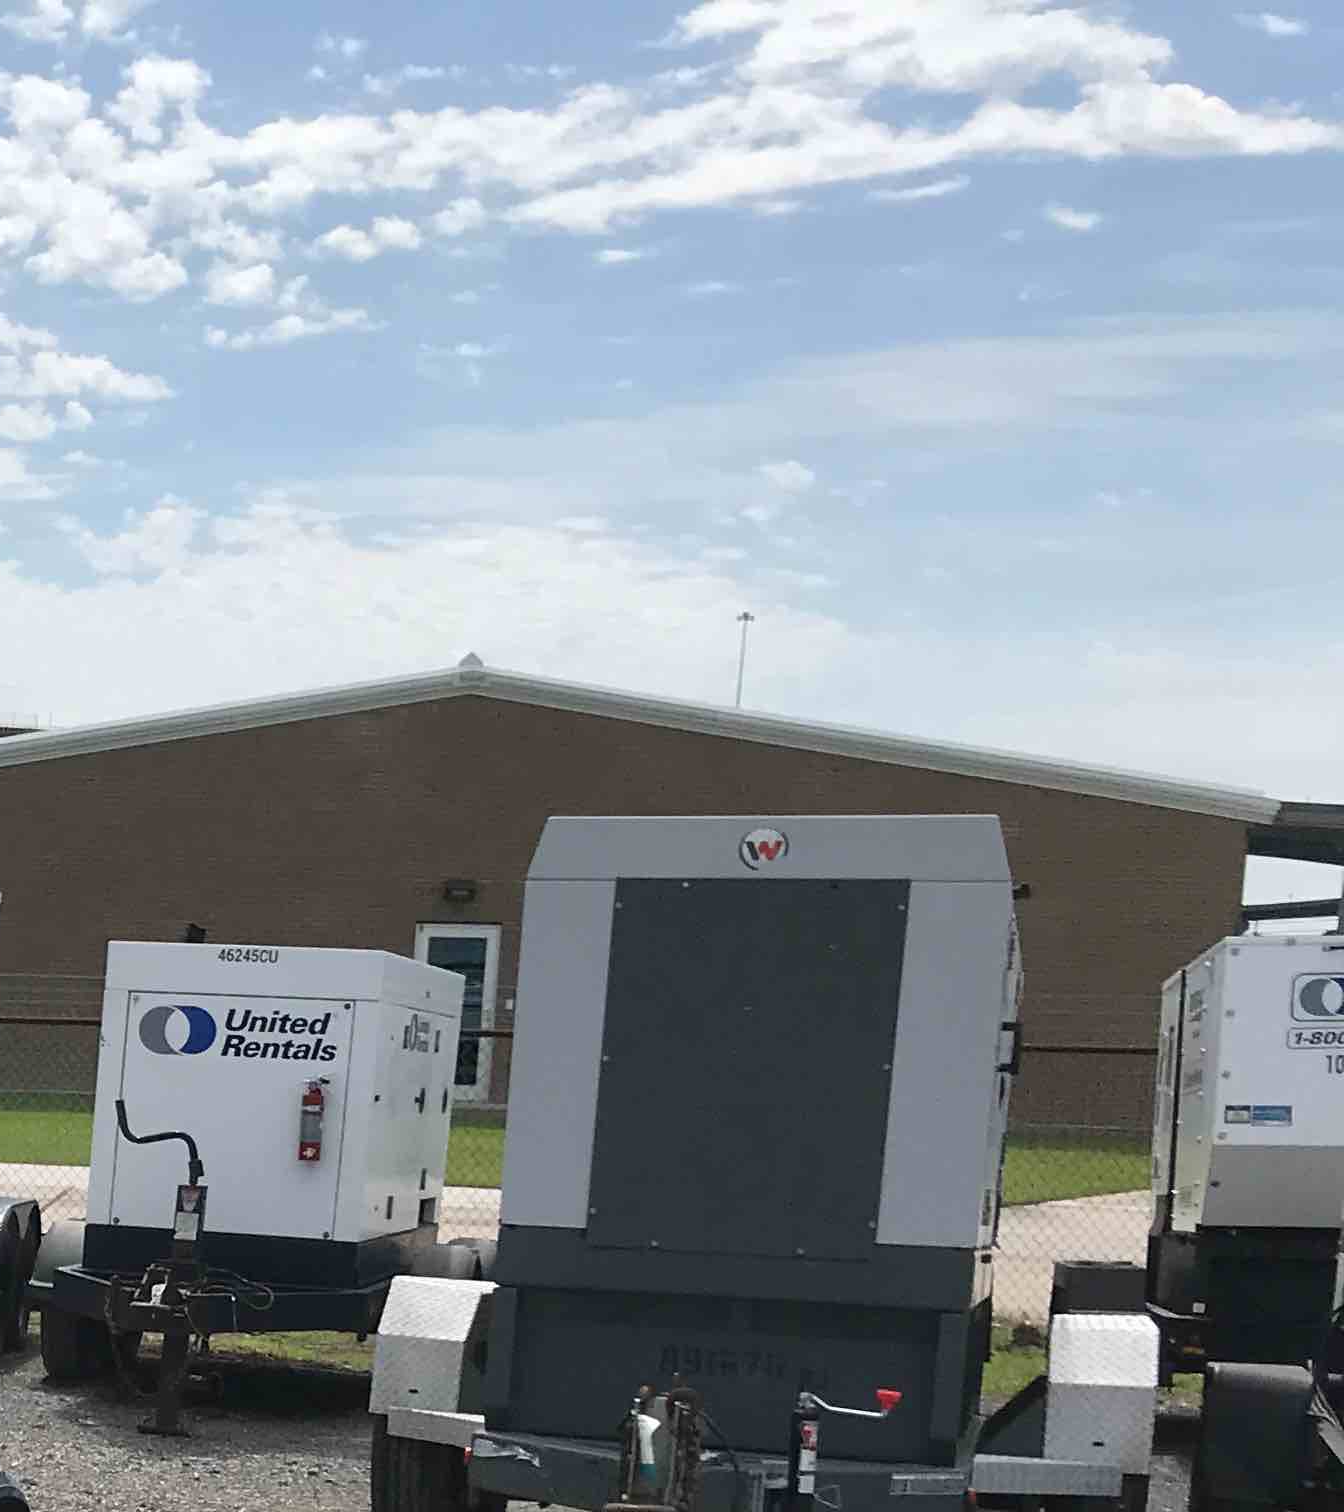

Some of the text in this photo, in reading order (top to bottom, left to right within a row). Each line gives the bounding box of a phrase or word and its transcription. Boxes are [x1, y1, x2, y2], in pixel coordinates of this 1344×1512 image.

[218, 949, 279, 964] 46245CU
[225, 1009, 331, 1035] United
[221, 1035, 337, 1061] Rentals
